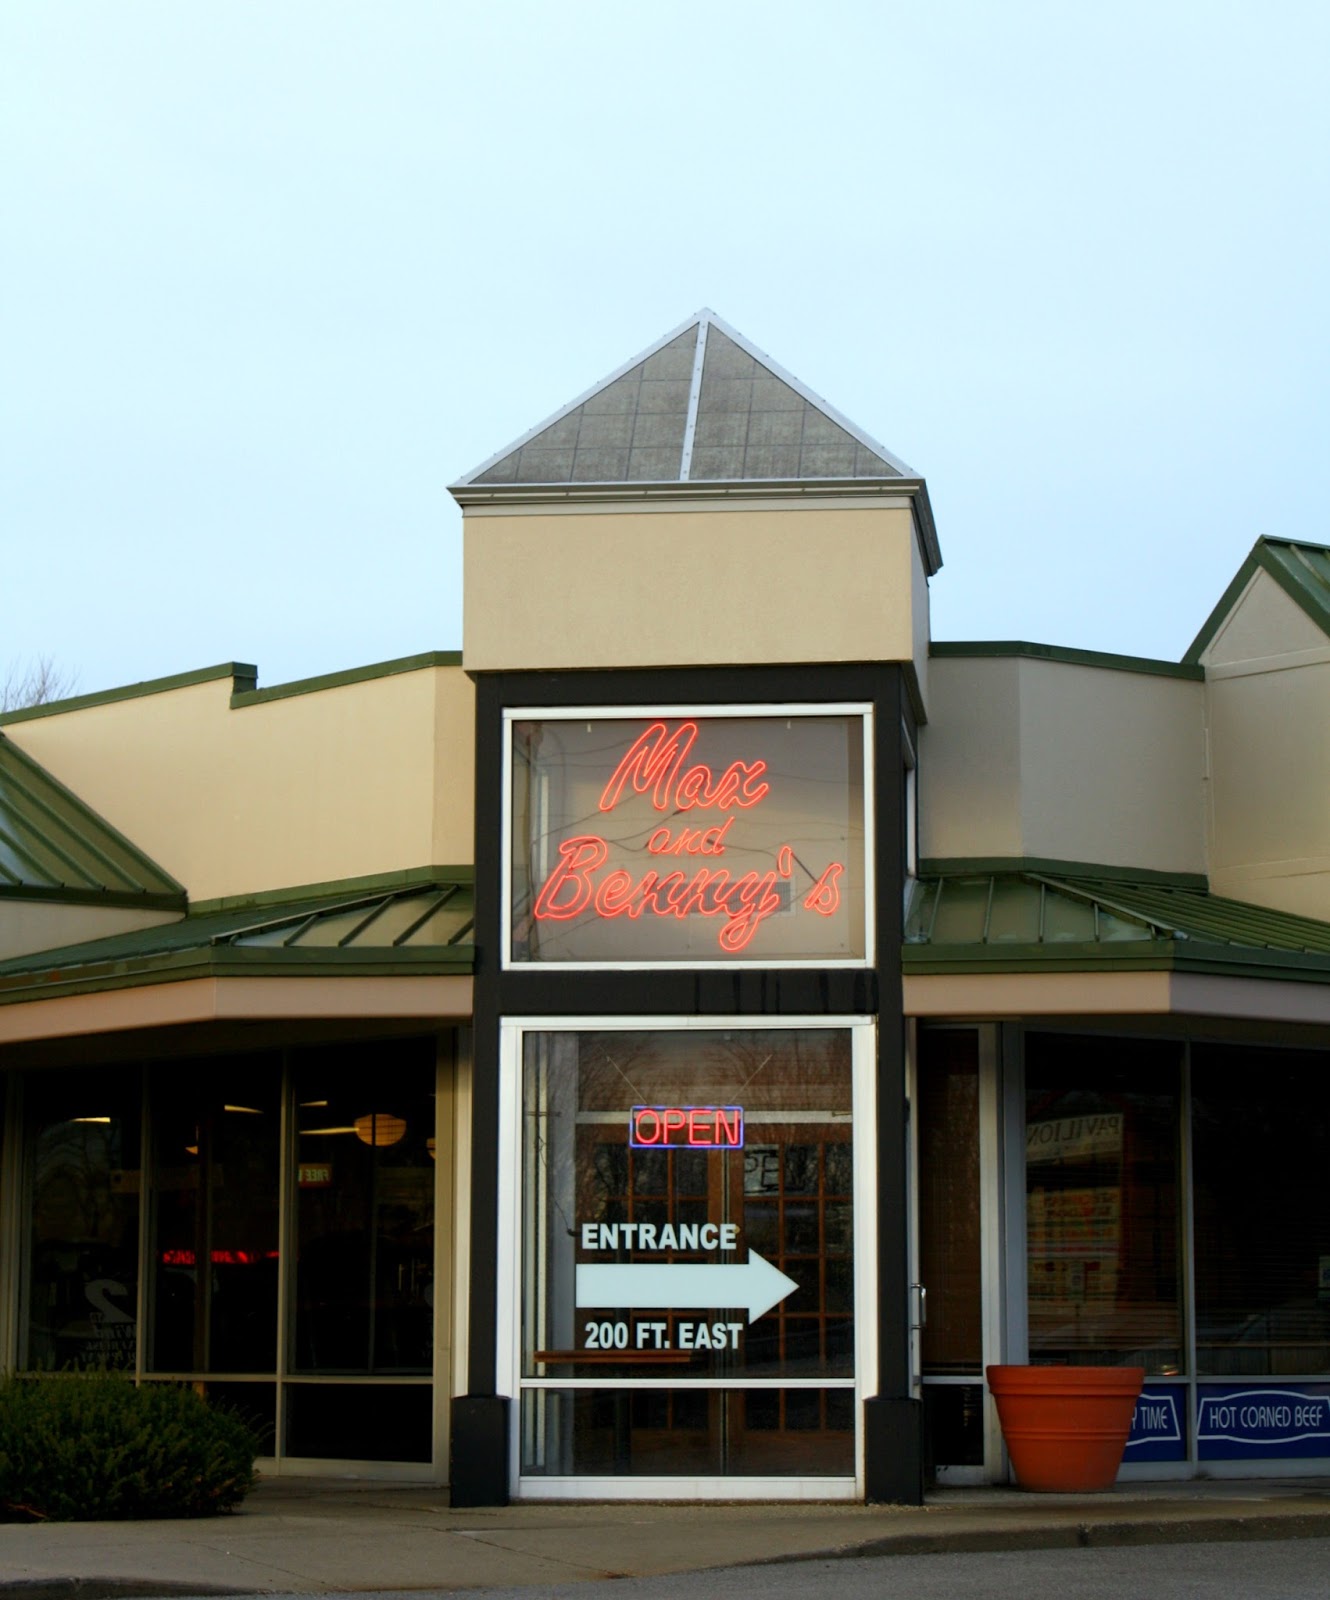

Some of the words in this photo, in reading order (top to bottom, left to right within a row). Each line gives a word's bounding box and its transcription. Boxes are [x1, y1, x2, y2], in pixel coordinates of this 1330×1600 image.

[598, 721, 770, 812] Max
[647, 815, 736, 857] and
[533, 834, 845, 953] Benny's
[634, 1109, 741, 1145] OPEN
[581, 1223, 737, 1250] ENTRANCE
[584, 1322, 629, 1350] 200
[635, 1322, 671, 1350] FT.
[678, 1322, 744, 1350] EAST
[1140, 1406, 1168, 1430] TIME
[1209, 1406, 1238, 1429] HOT
[1239, 1406, 1292, 1429] CORNED
[1294, 1405, 1325, 1428] BEEF
